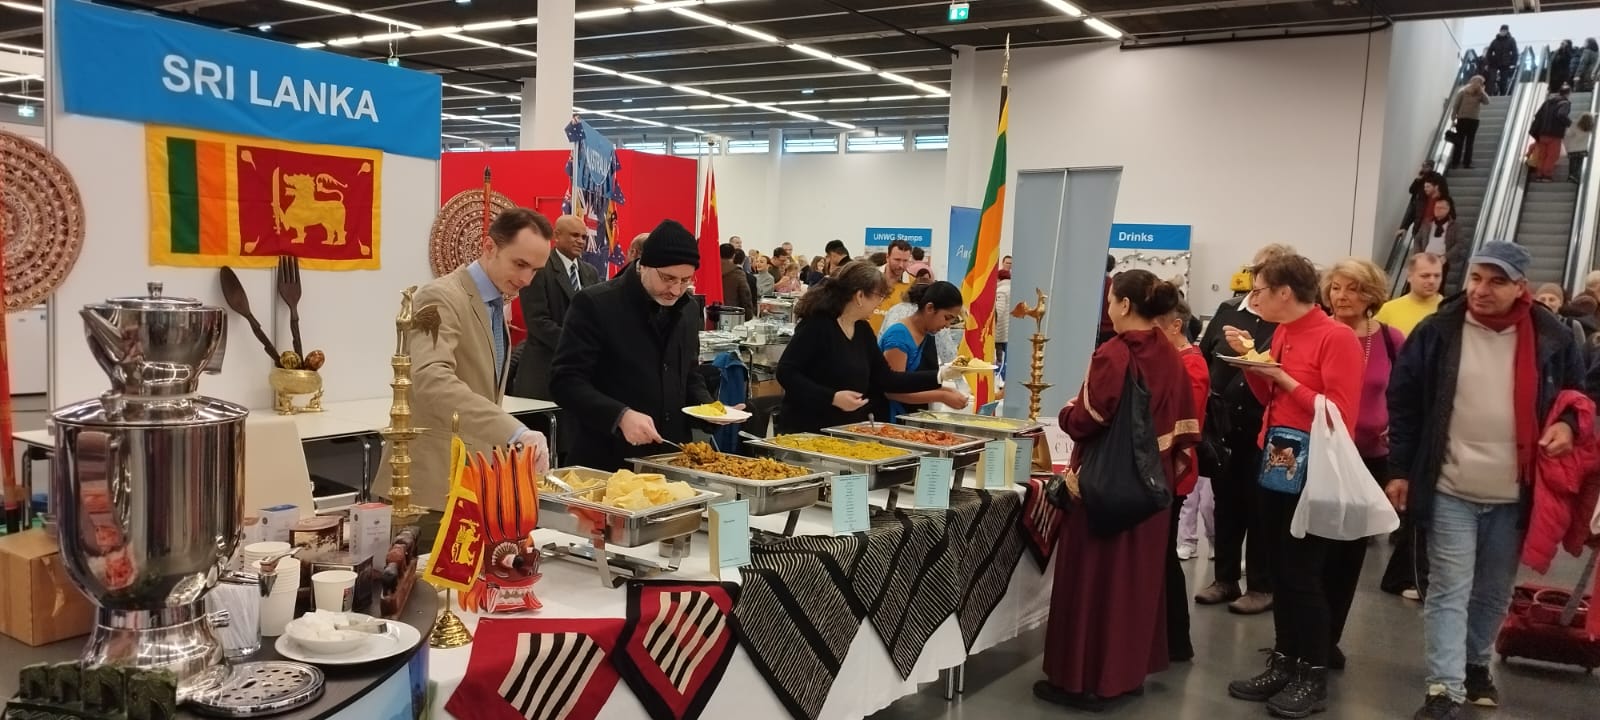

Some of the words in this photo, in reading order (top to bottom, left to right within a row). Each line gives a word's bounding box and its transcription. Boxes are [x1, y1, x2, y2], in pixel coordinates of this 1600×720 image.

[162, 54, 235, 101] SRI
[250, 70, 379, 123] LANKA
[873, 233, 896, 241] UNWG
[897, 234, 923, 244] Stamps
[1118, 231, 1154, 242] Drinks
